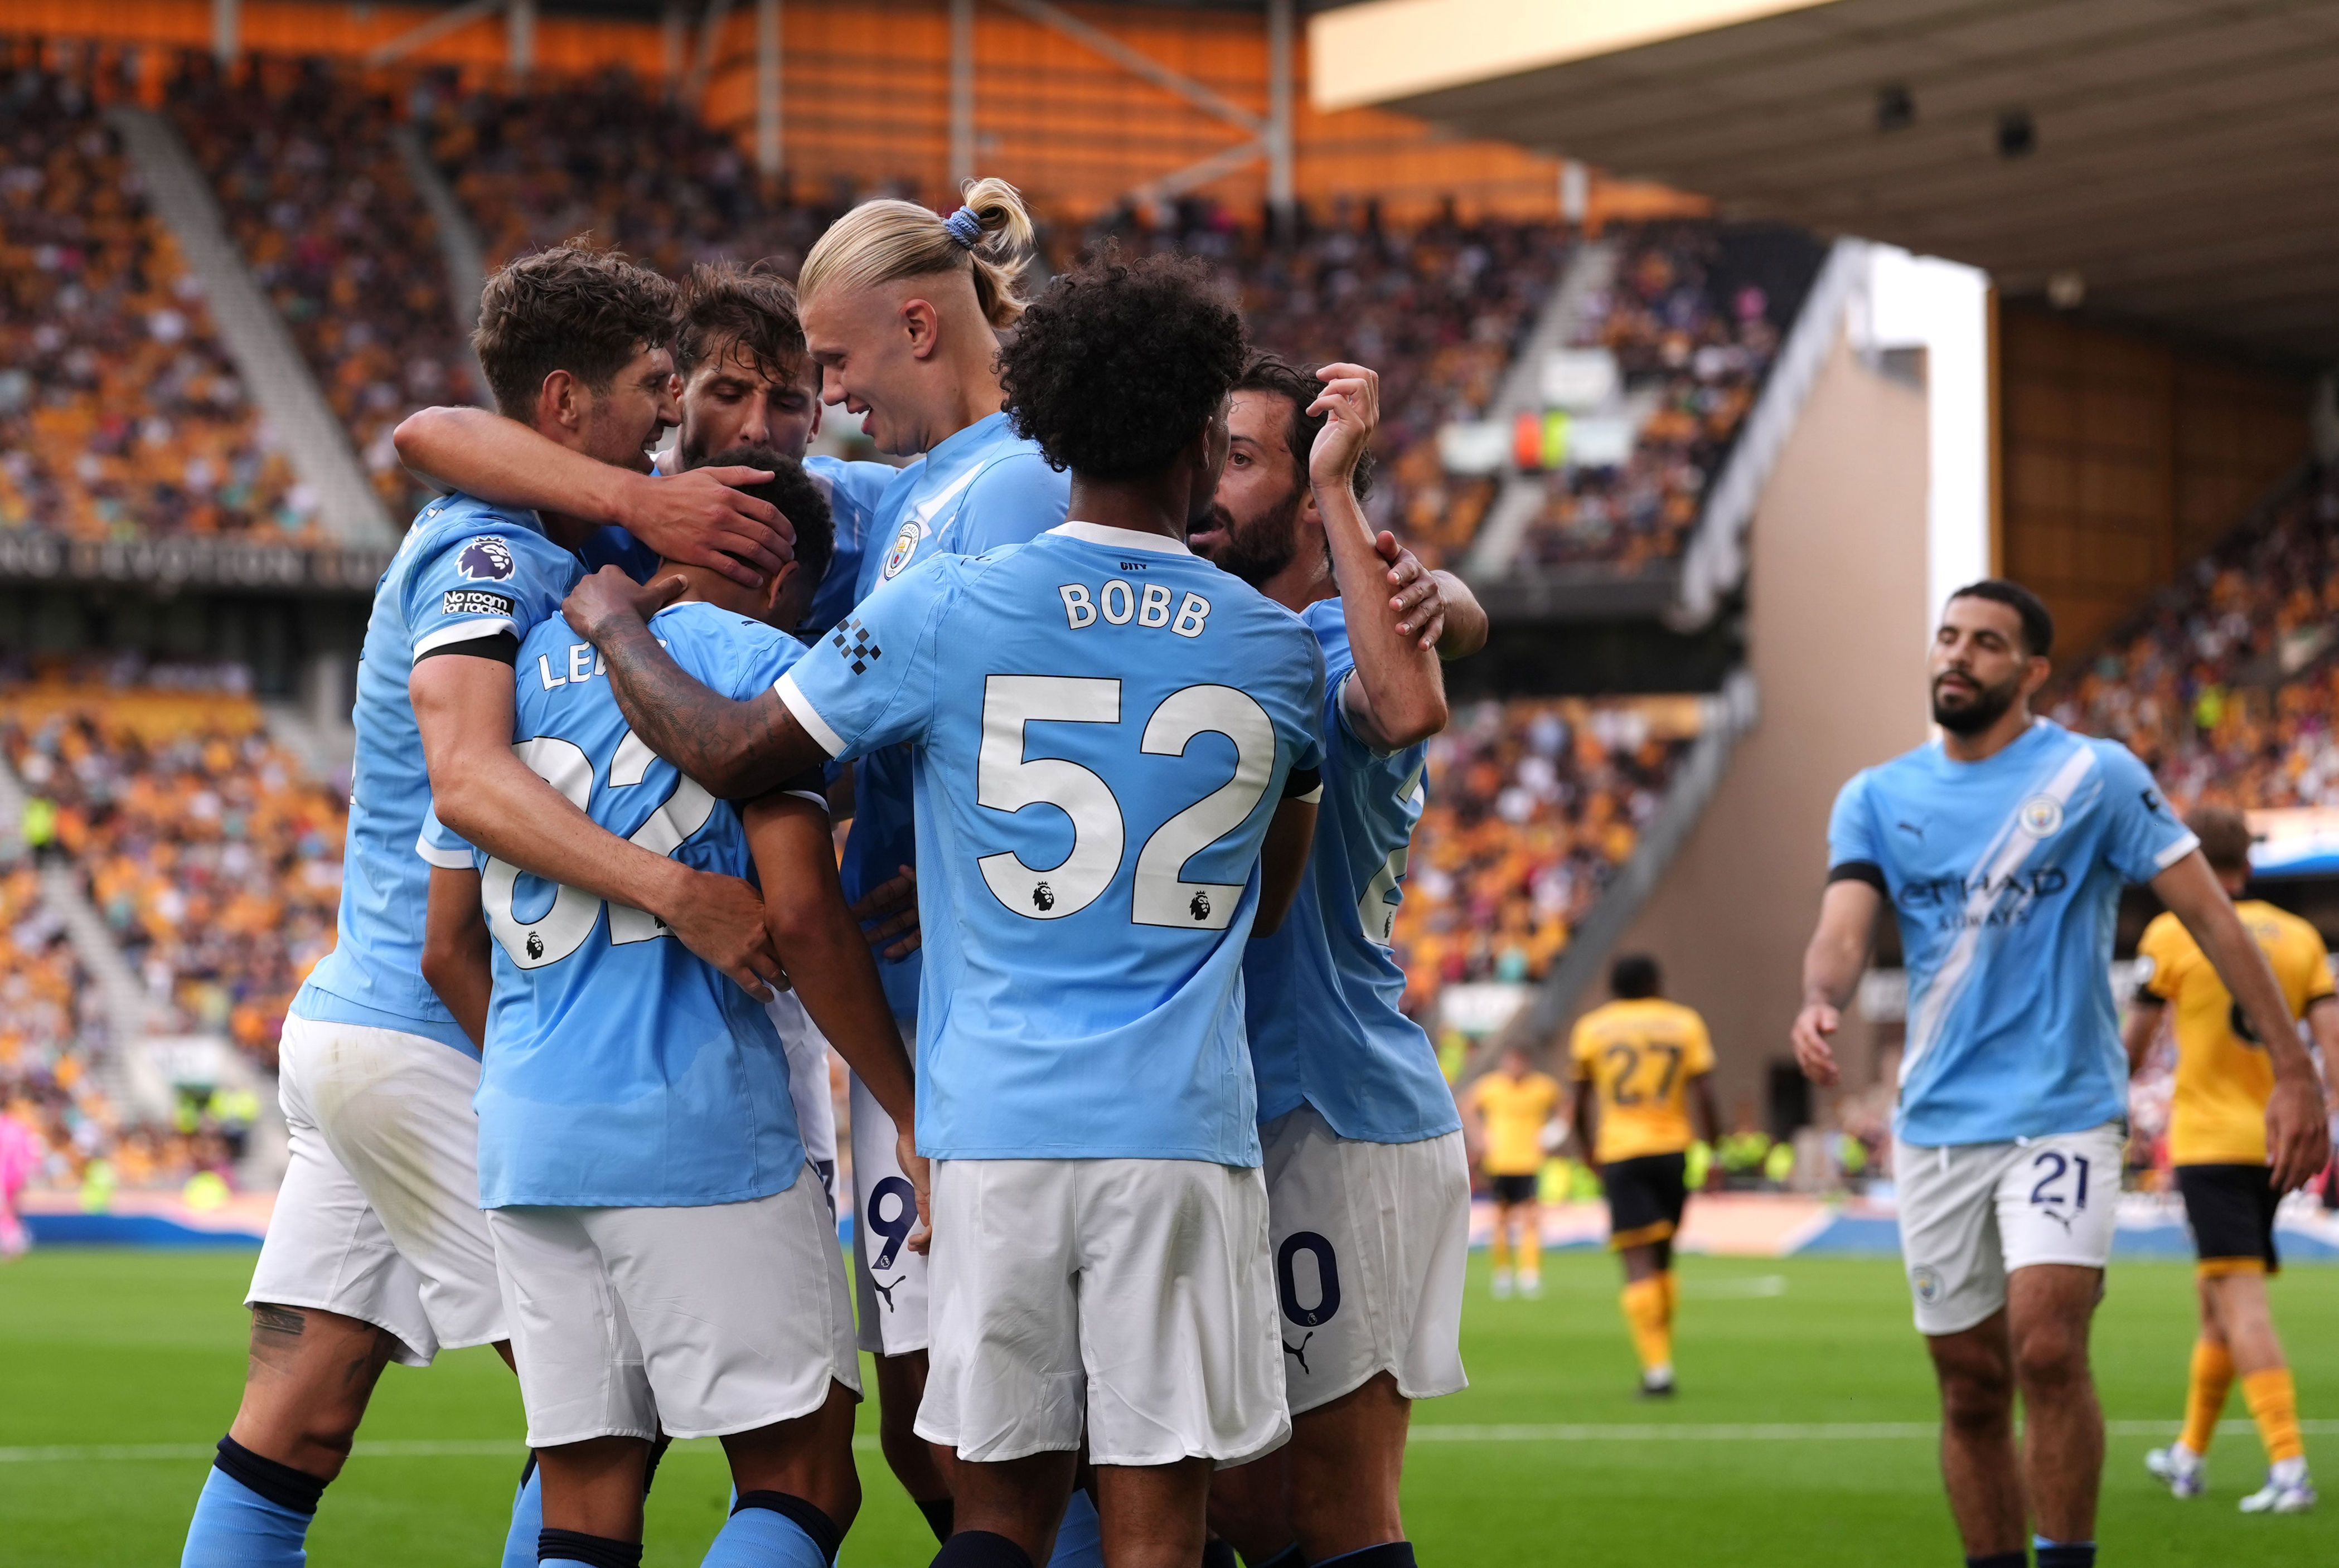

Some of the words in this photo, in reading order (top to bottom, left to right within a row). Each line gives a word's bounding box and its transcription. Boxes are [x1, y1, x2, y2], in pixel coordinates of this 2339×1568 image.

[1120, 562, 1147, 570] CITY
[442, 602, 463, 615] for
[444, 591, 464, 603] No
[466, 592, 507, 610] room
[1058, 579, 1212, 638] BOBB
[977, 673, 1277, 930] 52
[1606, 1040, 1683, 1101] 27
[2030, 1149, 2090, 1209] 21
[868, 1176, 918, 1270] 9
